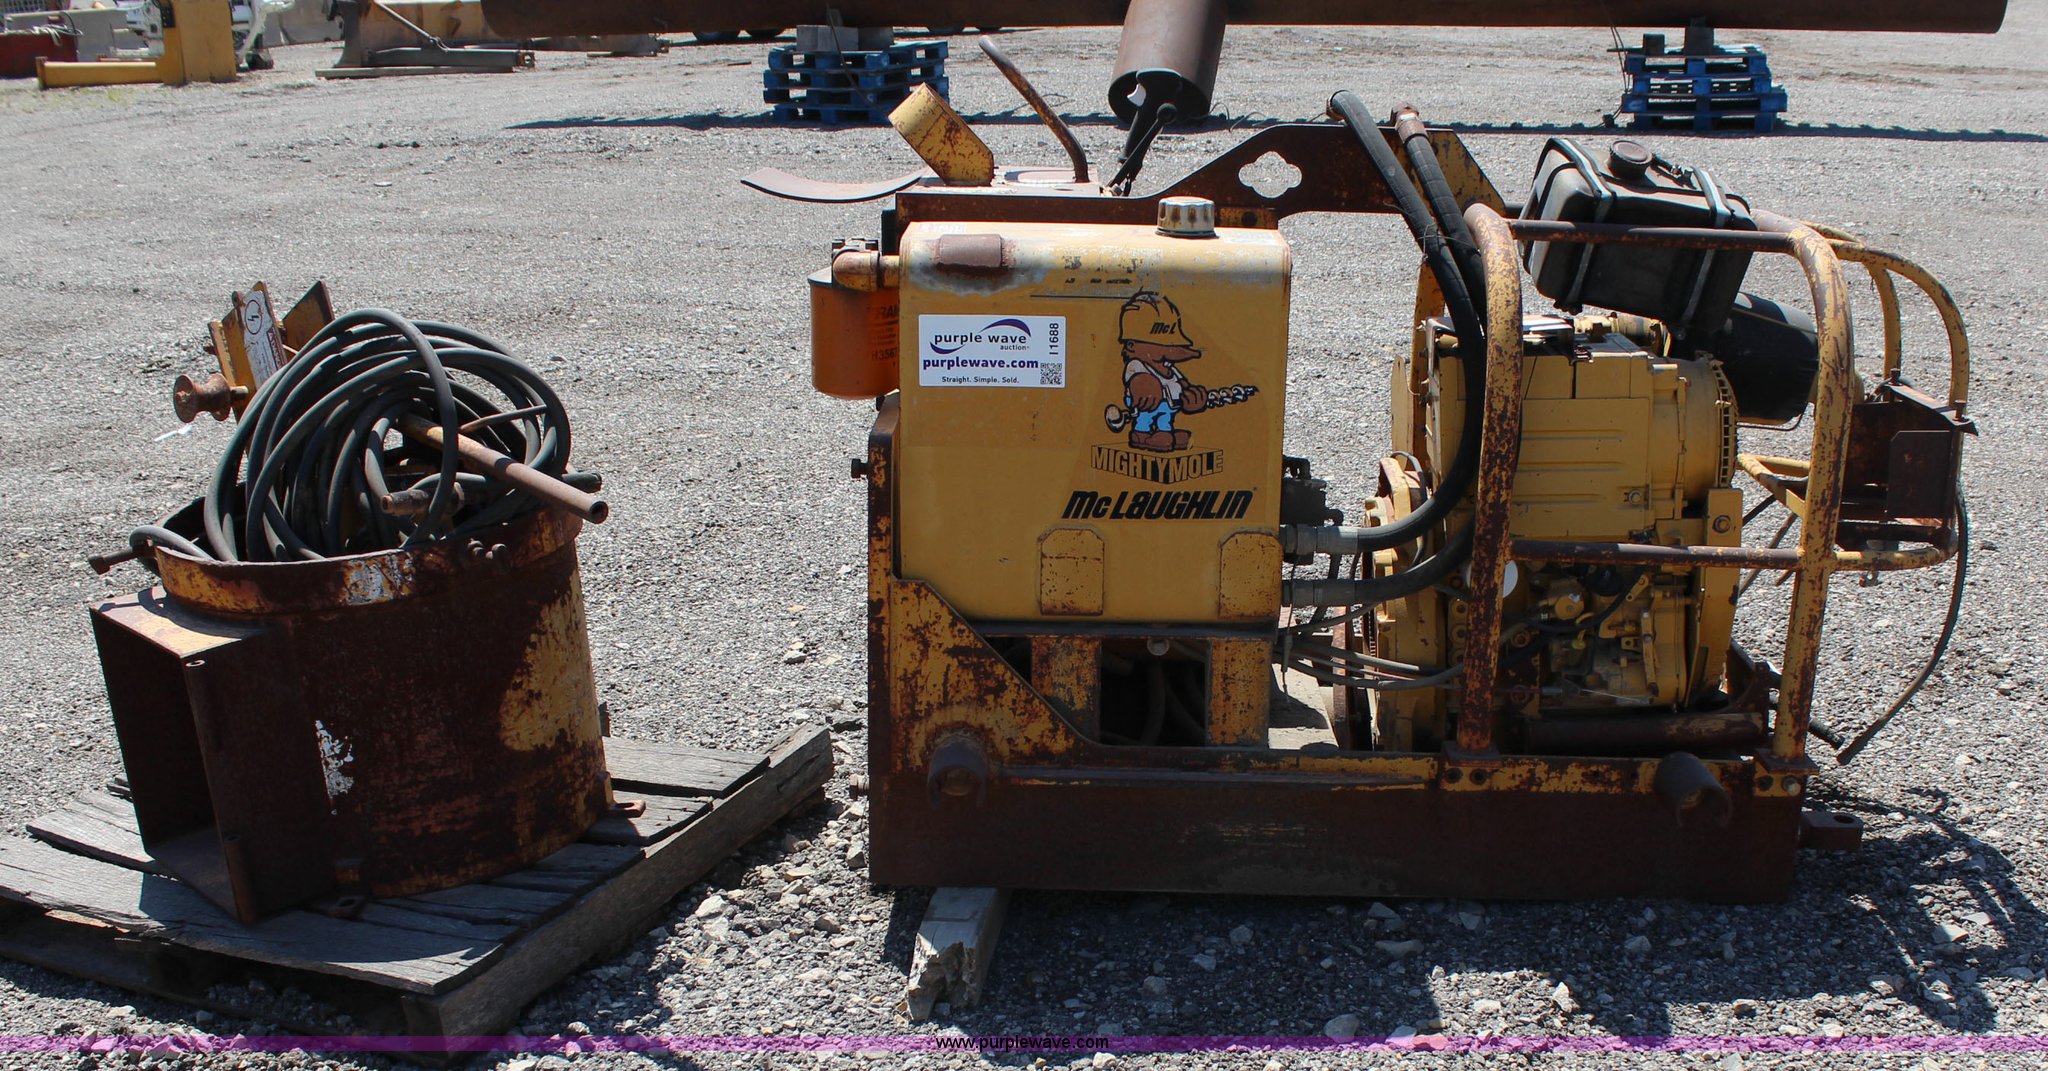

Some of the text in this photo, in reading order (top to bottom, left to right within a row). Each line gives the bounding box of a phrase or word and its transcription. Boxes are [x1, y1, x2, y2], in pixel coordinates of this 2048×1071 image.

[934, 332, 1027, 345] purple wave
[922, 356, 1039, 370] purplewave.com
[941, 376, 1020, 384] Straight. Simple. Sold.
